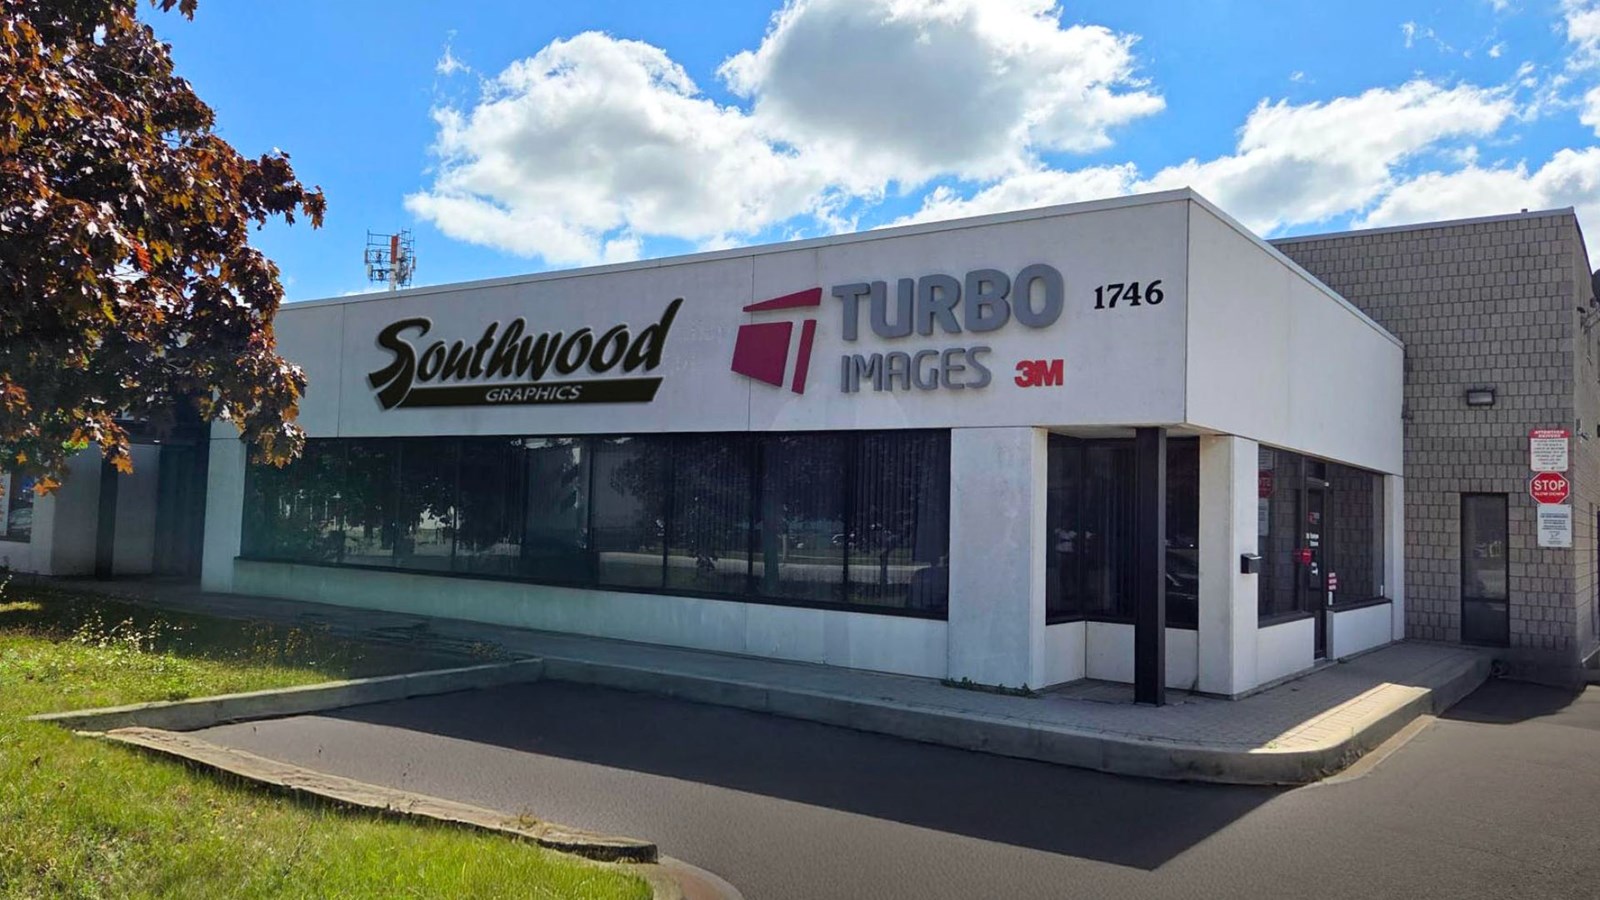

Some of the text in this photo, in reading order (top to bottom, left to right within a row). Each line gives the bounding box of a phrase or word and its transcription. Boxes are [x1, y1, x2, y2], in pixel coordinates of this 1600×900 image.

[831, 263, 1065, 341] TURBO
[1093, 279, 1164, 310] 1746
[368, 297, 685, 411] Southwood
[840, 346, 992, 393] IMAGES
[1014, 358, 1064, 388] 3M
[485, 384, 582, 402] GRAPHICS
[1534, 479, 1566, 491] STOP
